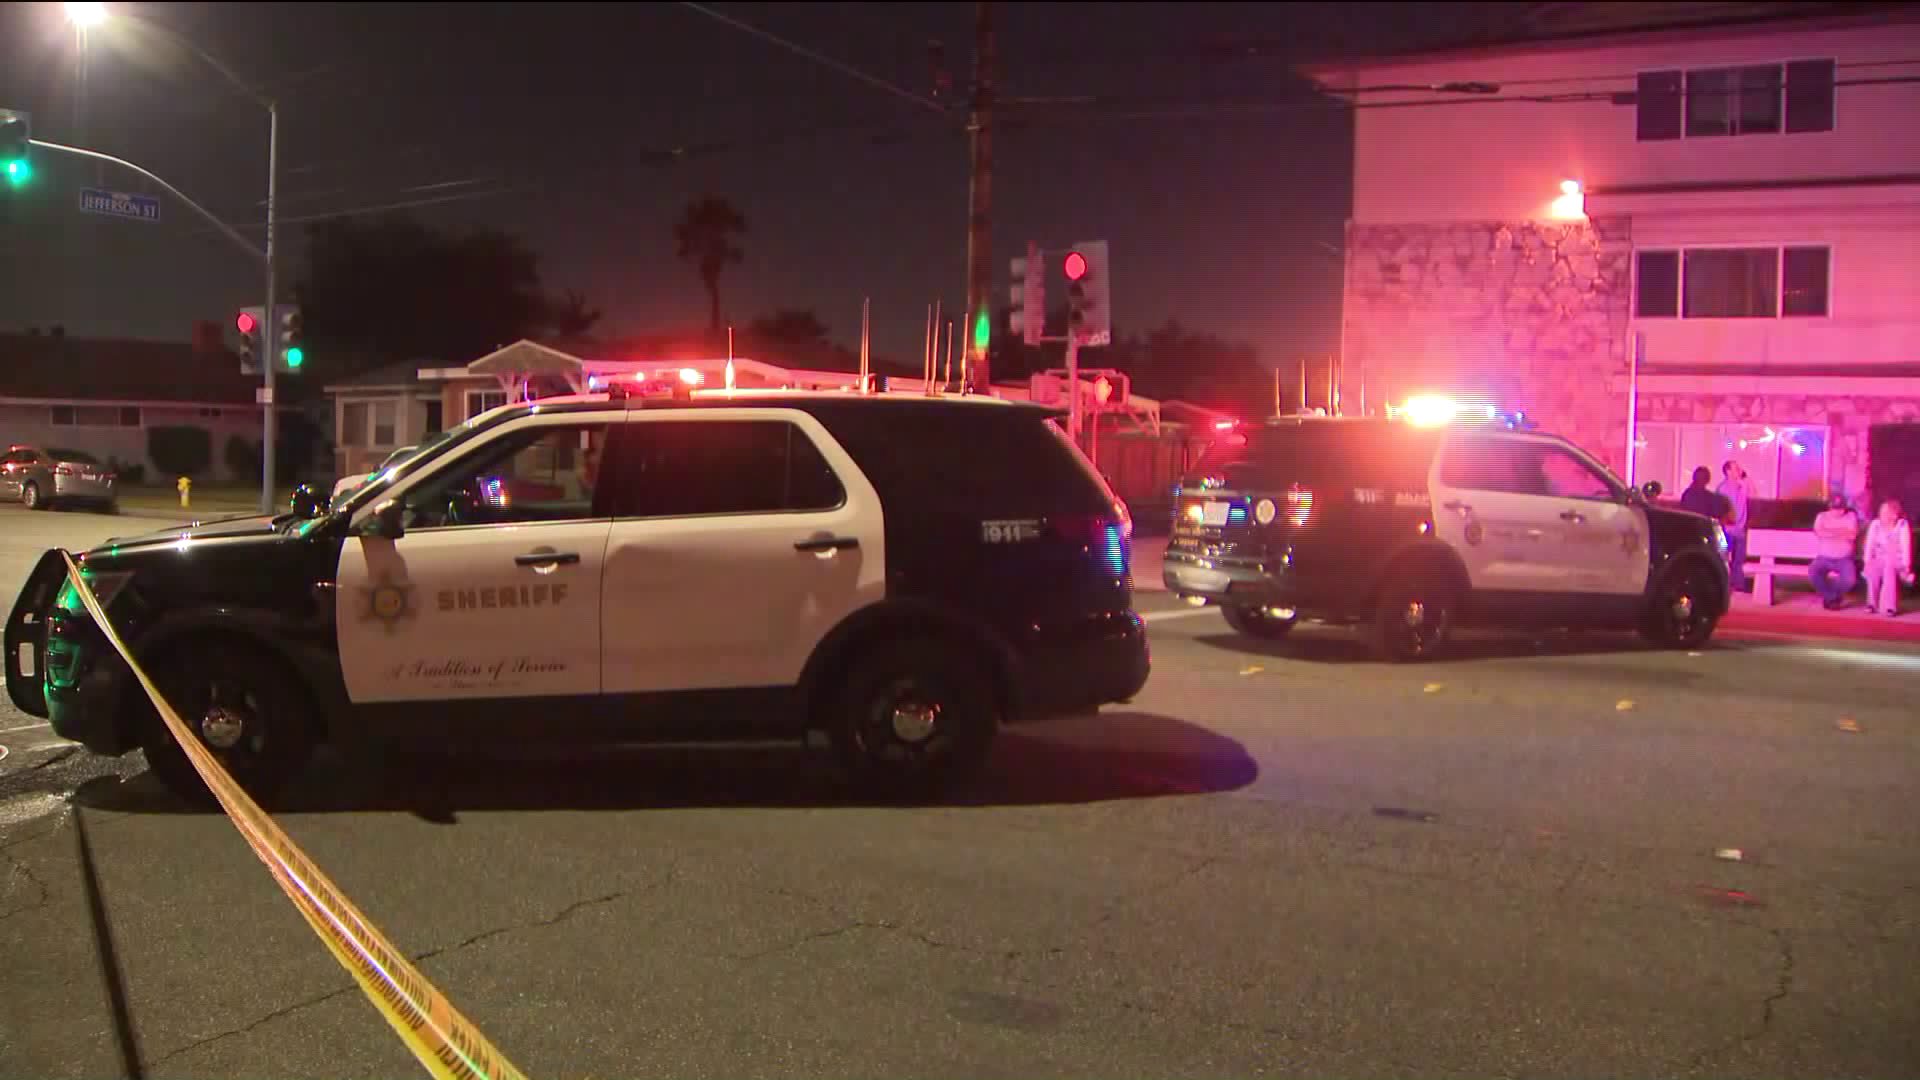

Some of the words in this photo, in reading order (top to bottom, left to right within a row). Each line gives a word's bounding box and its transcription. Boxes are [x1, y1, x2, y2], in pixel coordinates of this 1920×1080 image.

[83, 193, 140, 215] JEFFERSON
[143, 204, 156, 217] ST
[437, 583, 568, 612] SHERIFF
[409, 659, 482, 678] Tradition
[488, 661, 504, 680] of
